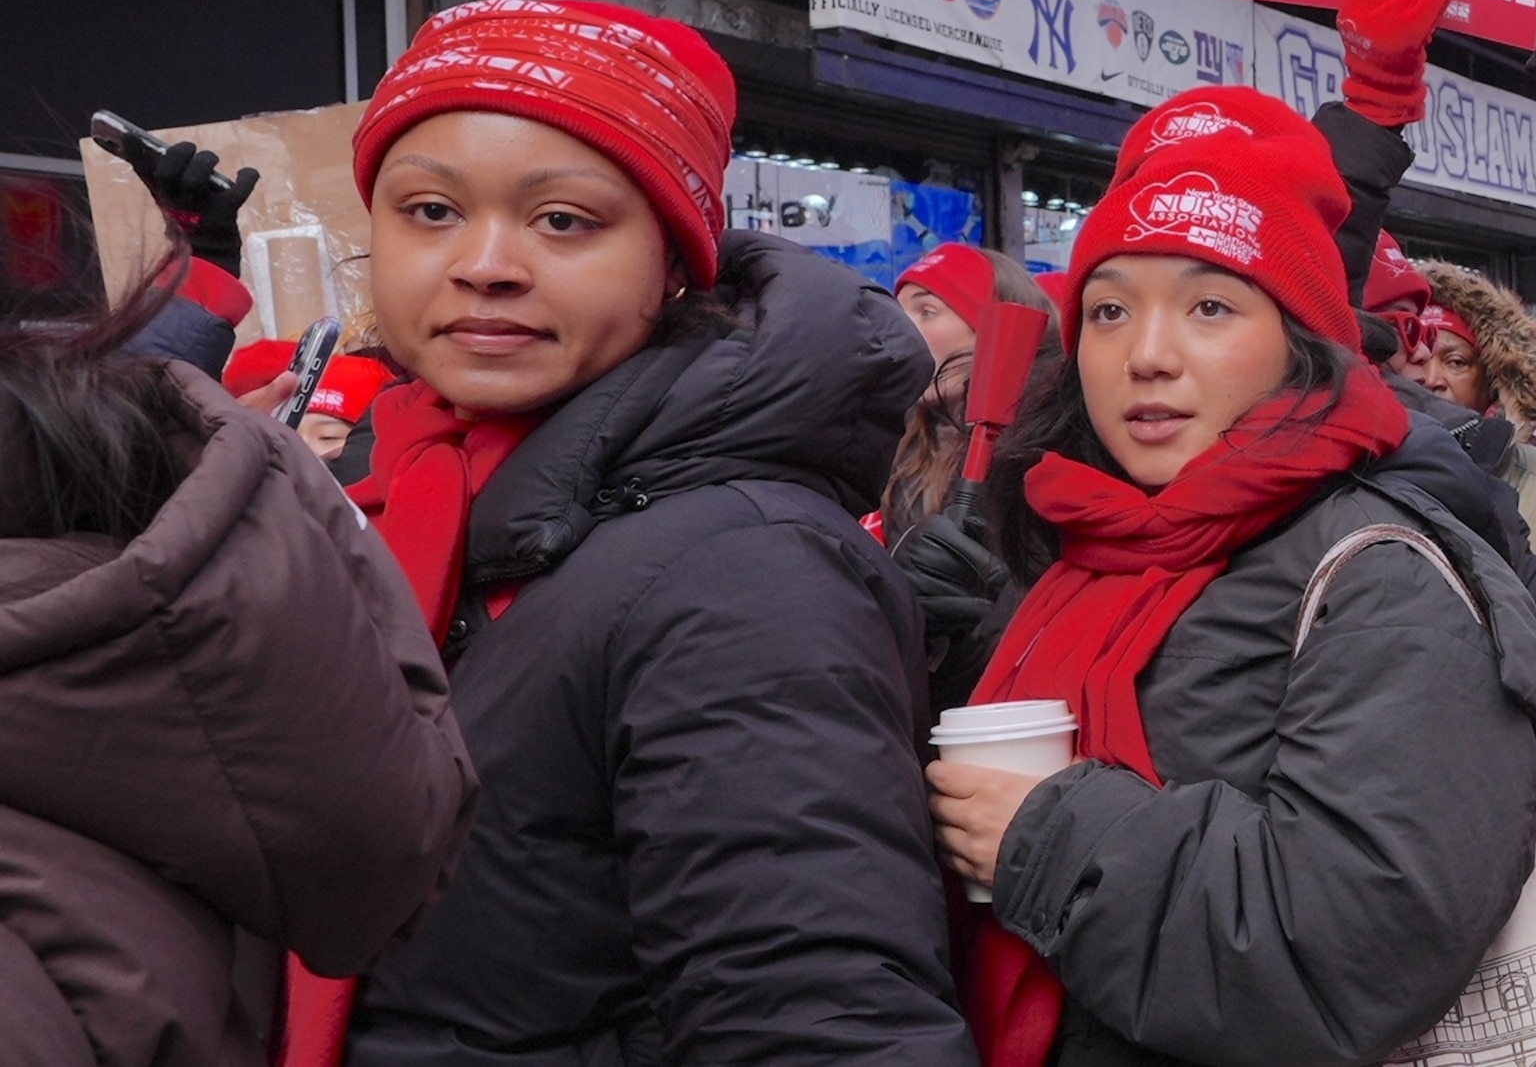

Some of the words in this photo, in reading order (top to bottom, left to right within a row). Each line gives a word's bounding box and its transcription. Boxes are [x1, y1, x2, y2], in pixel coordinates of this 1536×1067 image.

[1185, 187, 1211, 198] New
[1212, 190, 1237, 205] York
[1151, 193, 1263, 234] NURSES
